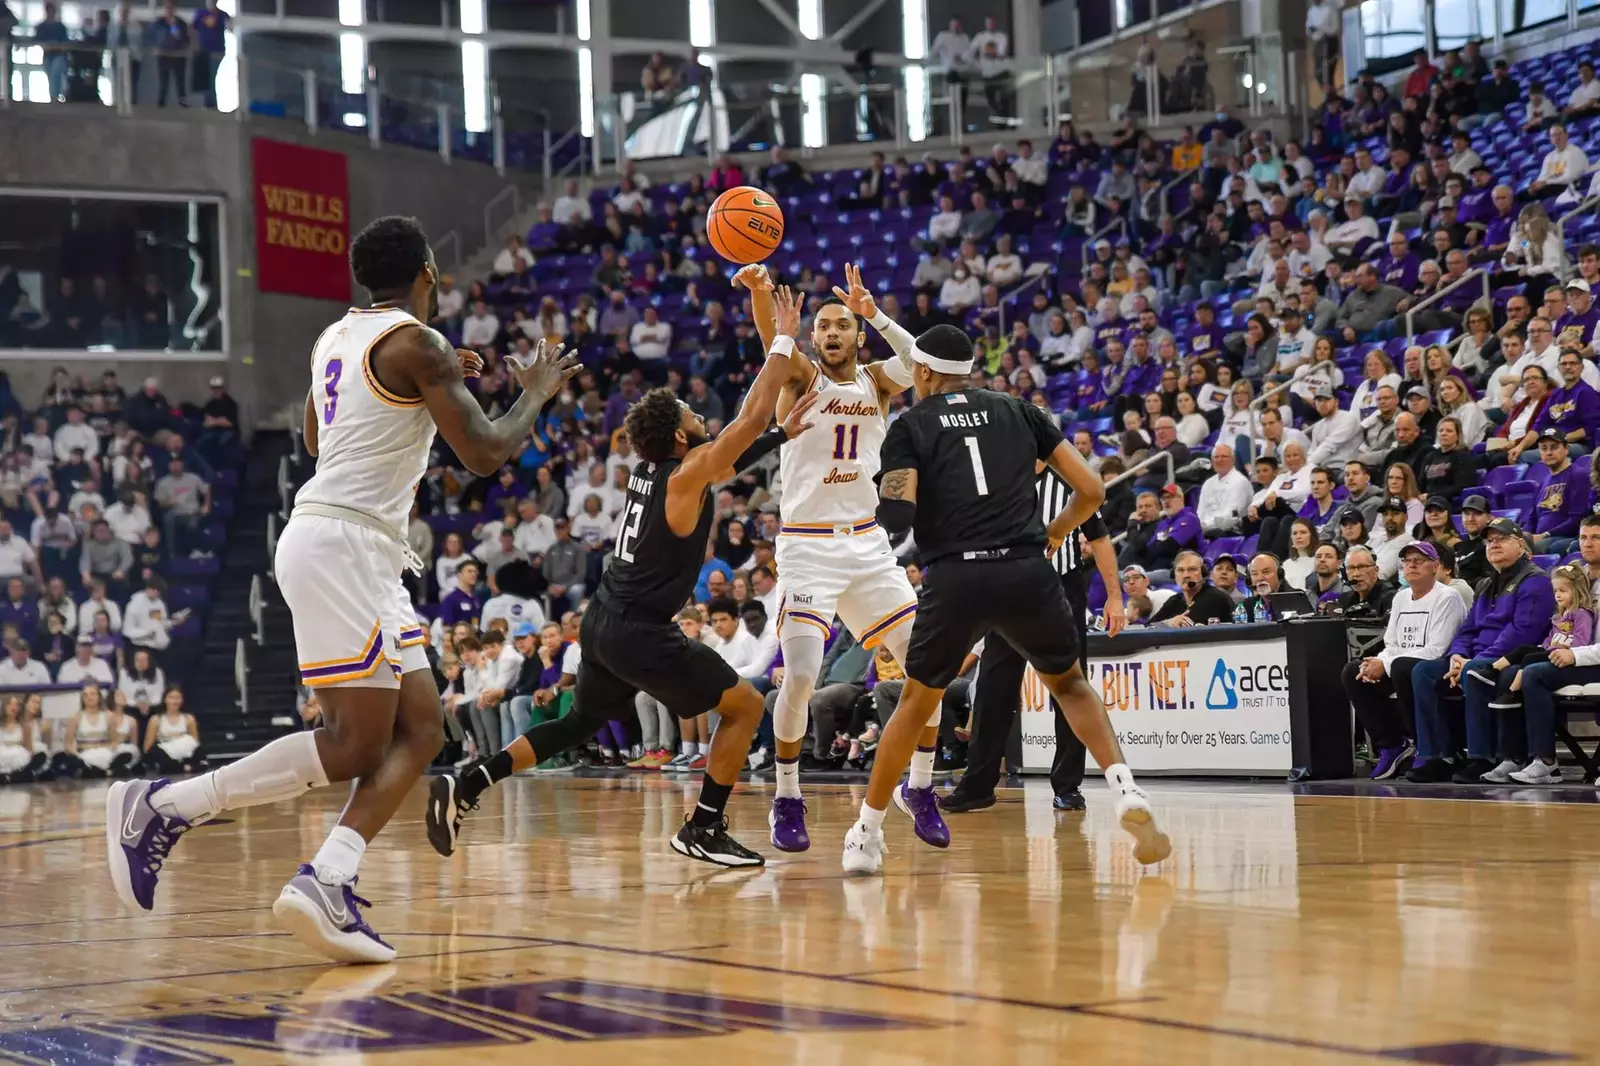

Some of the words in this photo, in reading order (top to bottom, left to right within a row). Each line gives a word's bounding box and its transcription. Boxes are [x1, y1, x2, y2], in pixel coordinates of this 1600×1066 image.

[261, 183, 344, 223] WELLS
[266, 217, 345, 255] FARGO
[748, 217, 780, 240] ELITE
[324, 356, 343, 426] 3
[939, 410, 989, 428] MOSLEY
[832, 423, 859, 461] 11
[823, 466, 859, 485] Iowa
[964, 436, 989, 496] 1
[614, 499, 645, 563] 12
[1102, 662, 1142, 712] BUT
[1148, 660, 1195, 710] NET.
[1242, 698, 1263, 708] TRUST
[1266, 695, 1274, 707] IT
[1276, 697, 1286, 707] TO
[1127, 731, 1164, 748] Security
[1166, 730, 1179, 744] for
[1181, 731, 1203, 744] Over
[1205, 733, 1217, 747] 25
[1219, 731, 1248, 745] Years.
[1250, 730, 1280, 744] Game
